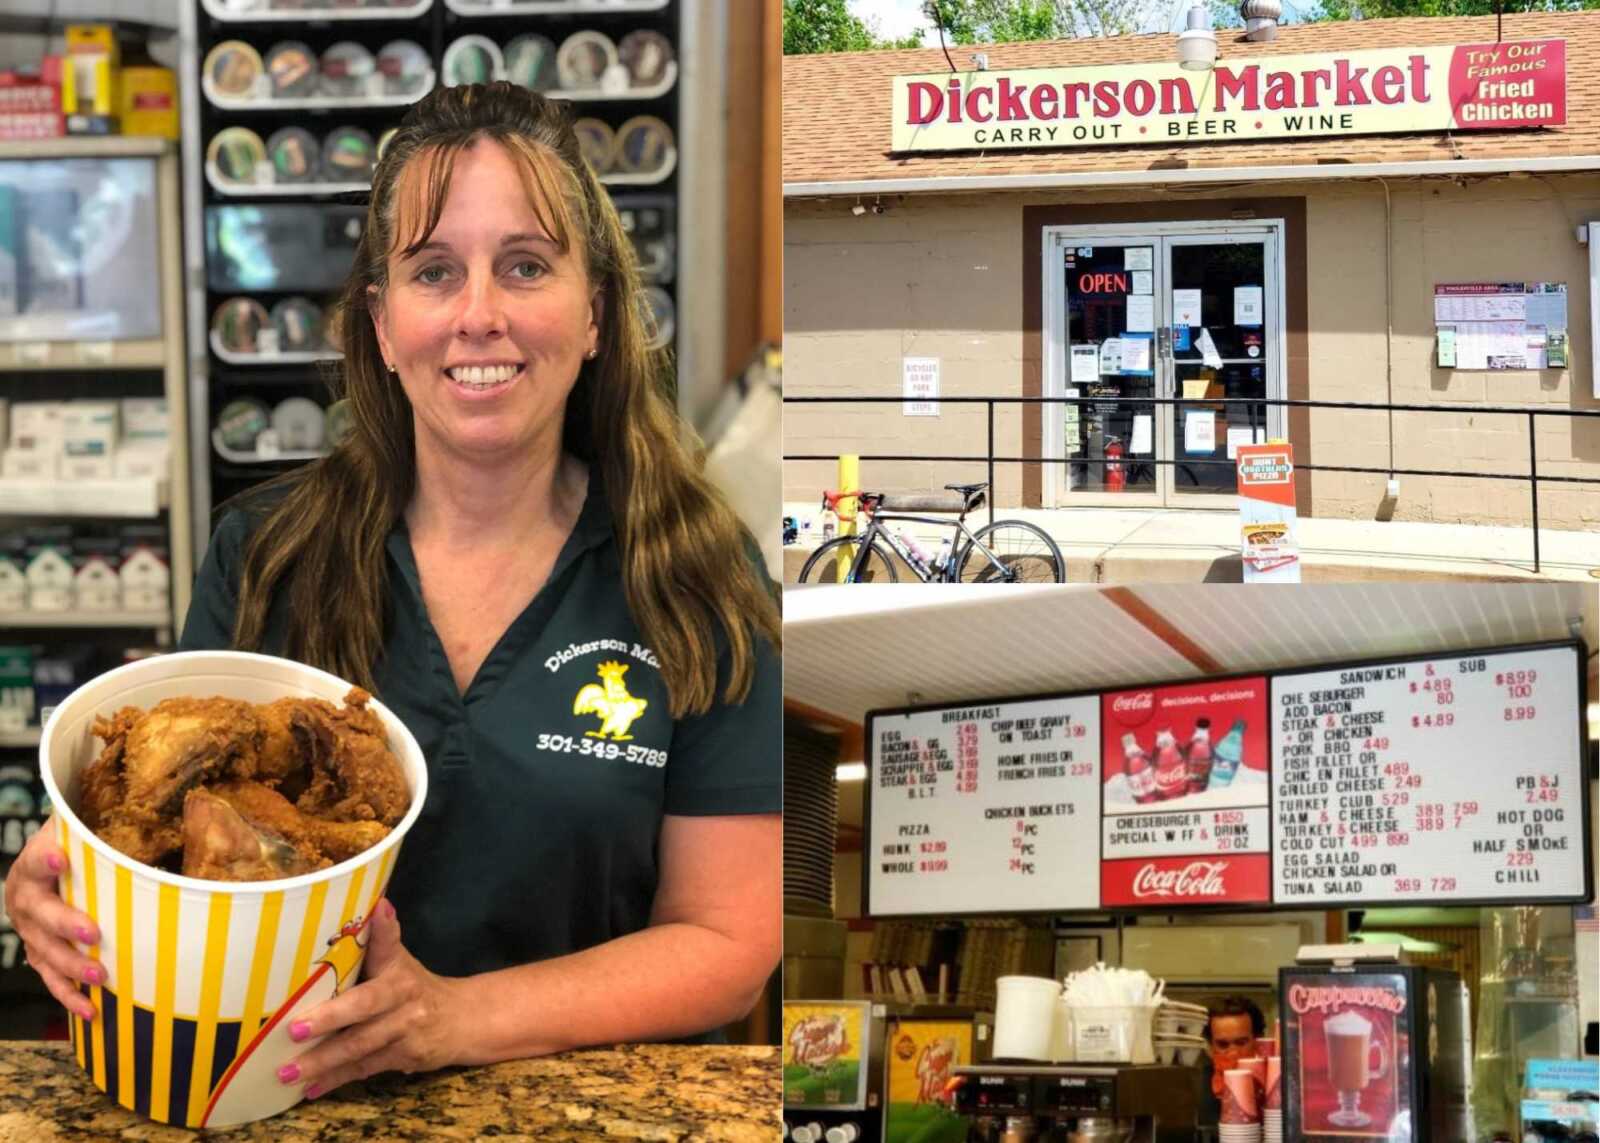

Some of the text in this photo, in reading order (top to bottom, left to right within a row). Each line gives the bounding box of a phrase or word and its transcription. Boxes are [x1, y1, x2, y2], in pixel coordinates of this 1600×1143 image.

[1466, 44, 1546, 65] Try Our
[1467, 59, 1546, 80] Famous
[906, 54, 1432, 124] Dickerson Market
[1479, 80, 1534, 99] Fried
[1462, 101, 1552, 122] Chicken
[974, 113, 1353, 143] CARRY OUT BEER WINE
[1080, 274, 1126, 293] OPEN
[544, 639, 627, 672] Dickerson
[1340, 659, 1486, 685] SANDWICH & SUB
[1210, 690, 1255, 702] decisions
[942, 707, 1000, 723] BREAKFAST
[1313, 702, 1352, 715] BACON
[991, 720, 1014, 732] CHIP
[1040, 716, 1070, 727] GRAVY
[1282, 719, 1318, 732] STEAK
[1326, 714, 1335, 727] &
[1342, 711, 1384, 727] CHEESE
[882, 731, 901, 741] EGG
[1000, 732, 1012, 743] ON
[1022, 728, 1052, 741] TOAST
[1298, 726, 1372, 743] OR CHICKEN
[536, 734, 668, 768] 301-349-5789
[881, 741, 911, 752] BACON
[1283, 746, 1313, 757] PORK
[1324, 741, 1351, 754] BBQ
[881, 752, 919, 763] SAUSAGE
[998, 754, 1025, 766] HOME
[1030, 752, 1057, 764] FRIES
[1284, 751, 1376, 770] FISH FILLET OR
[881, 776, 907, 788] STEAK
[920, 773, 936, 784] EGG
[998, 767, 1034, 780] FRENCH
[1038, 766, 1065, 778] FRIES
[1280, 782, 1328, 797] GRILLED
[1336, 778, 1384, 793] CHEESE
[1280, 798, 1328, 812] TURKEY
[1340, 795, 1373, 808] CLUB
[985, 807, 1025, 819] CHICKEN
[1280, 812, 1308, 824] HAM
[1320, 811, 1328, 823] &
[1497, 808, 1564, 824] HOT DOG
[899, 824, 930, 836] PIZZA
[1024, 824, 1038, 836] PC
[1110, 830, 1157, 845] SPECIAL
[1165, 830, 1175, 841] W
[1182, 829, 1193, 840] FF
[1214, 824, 1248, 837] DRINK
[1285, 824, 1331, 837] TURKEY
[1337, 823, 1346, 835] &
[1350, 820, 1398, 834] CHEESE
[1523, 824, 1544, 837] OR
[883, 844, 911, 855] HUNK
[1021, 843, 1034, 855] PC
[1234, 836, 1248, 848] OZ
[1281, 838, 1313, 850] COLD
[1320, 836, 1346, 849] CUT
[1473, 839, 1505, 853] HALF
[1284, 852, 1359, 866] EGG SALAD
[882, 862, 914, 873] WHOLE
[1021, 862, 1034, 874] PC
[1283, 862, 1396, 879] CHICKEN SALAD OR
[1133, 861, 1229, 897] Coca-Cola
[1495, 870, 1540, 883] CHILI
[1284, 882, 1314, 895] TUNA
[1324, 880, 1362, 894] SALAD
[1289, 984, 1406, 1013] Cappuccino
